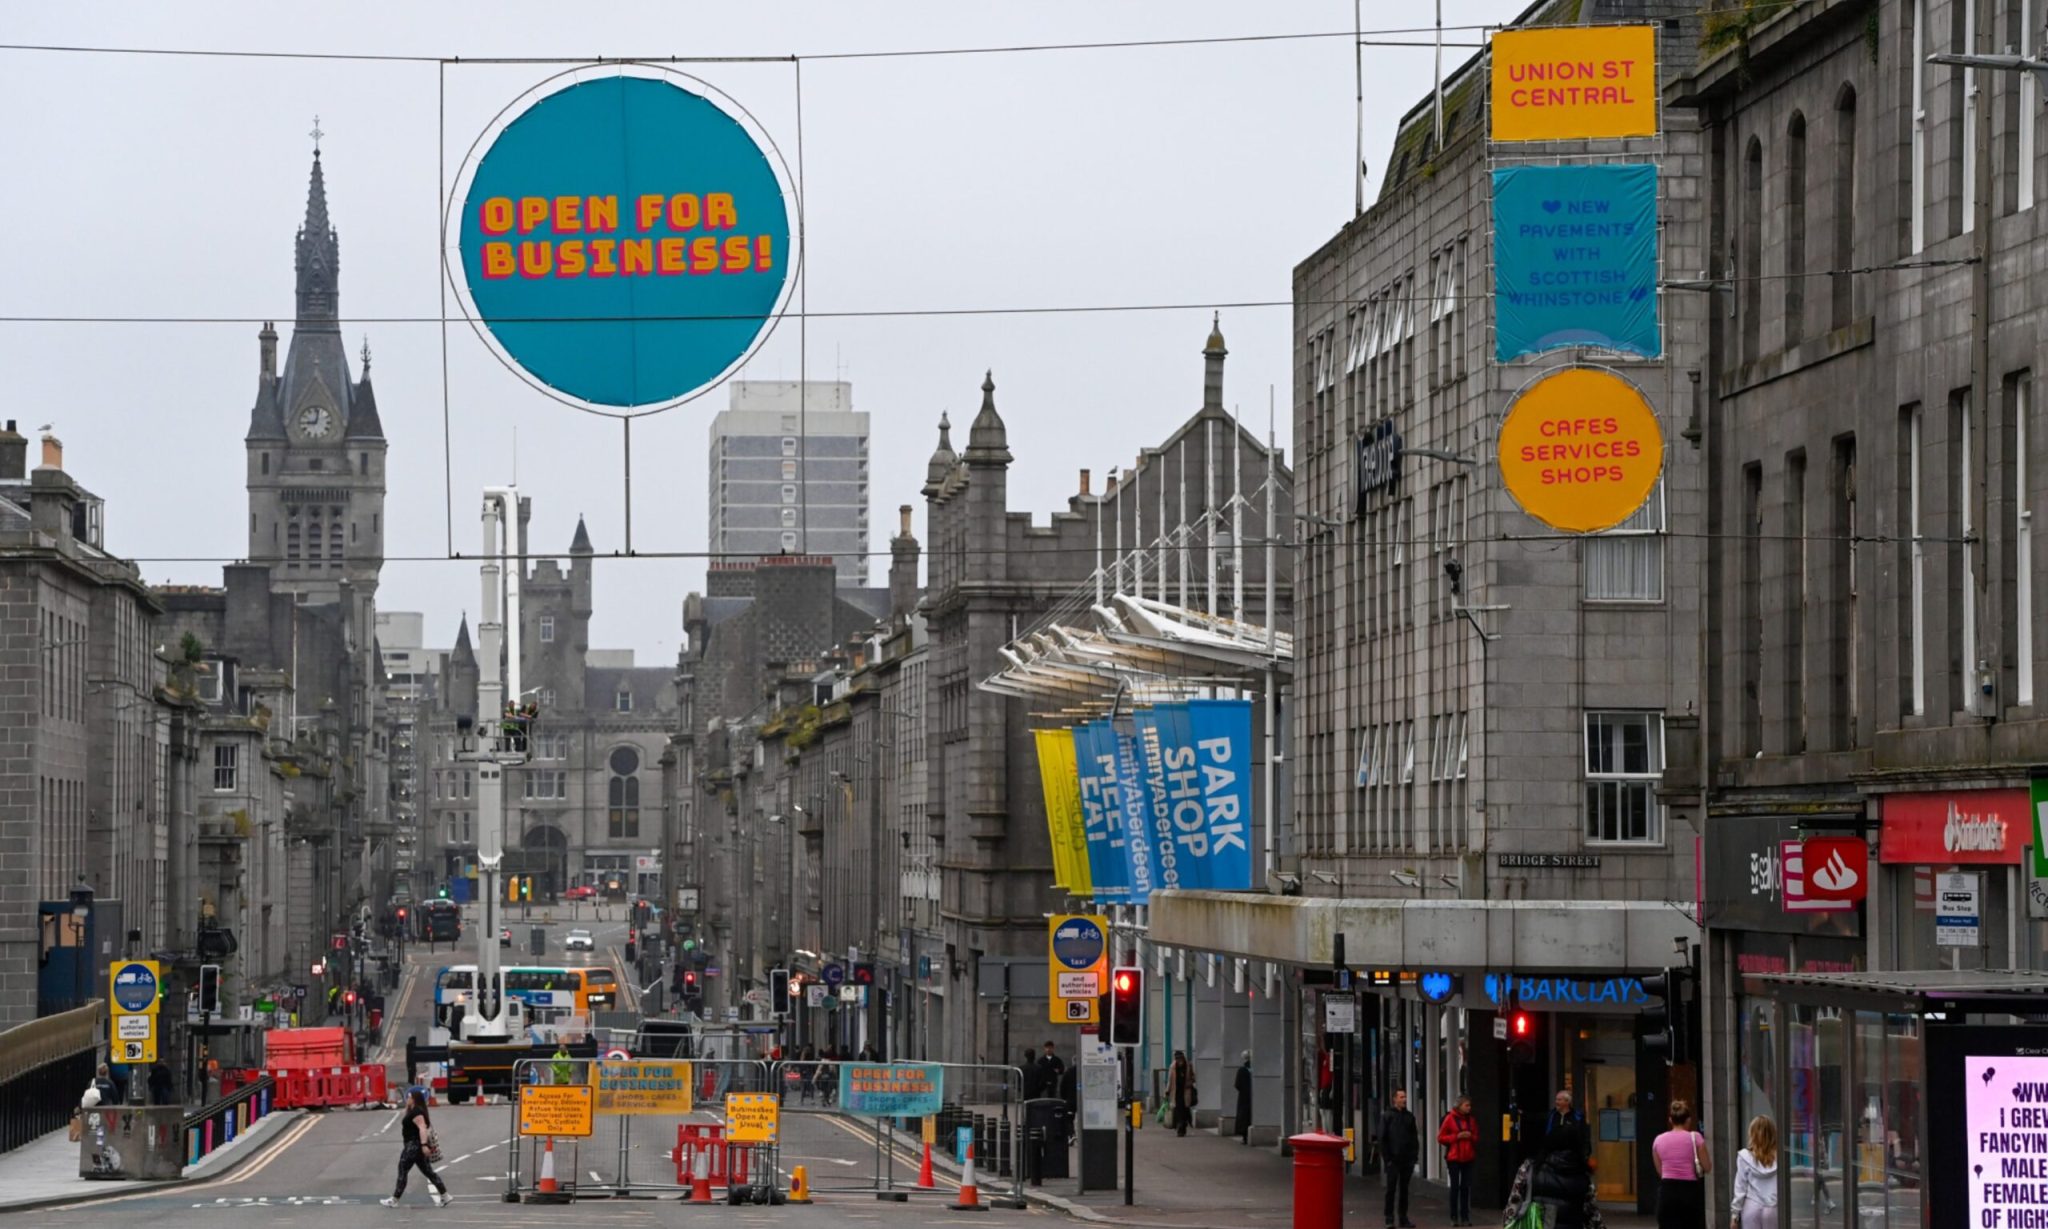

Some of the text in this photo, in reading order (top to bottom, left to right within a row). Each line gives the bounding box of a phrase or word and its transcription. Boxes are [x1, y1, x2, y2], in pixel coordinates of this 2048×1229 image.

[1509, 60, 1635, 82] UNION ST
[1510, 86, 1635, 107] CENTRAL
[479, 192, 737, 236] OPEN FOR
[1567, 200, 1610, 215] NEW
[1519, 223, 1634, 238] PAVEMENTS
[481, 235, 773, 279] BUSINESS!
[1553, 247, 1600, 261] WITH
[1529, 270, 1627, 286] SCOTTISH
[1508, 290, 1623, 307] WHINSTONE
[1540, 417, 1618, 437] CAFES
[1521, 440, 1641, 462] SERVICES
[1541, 465, 1624, 485] SHOPS
[1164, 746, 1209, 858] SHOP
[1198, 737, 1246, 856] PARK
[1500, 855, 1600, 866] BRIDGE STREET
[1519, 978, 1649, 1003] BARCLAYS
[600, 1066, 673, 1078] OPEN FOR
[851, 1068, 926, 1080] OPEN FOR
[599, 1079, 684, 1091] BUSINESS!
[851, 1081, 935, 1093] BUSINESS!
[740, 1121, 763, 1129] Usual
[2000, 1107, 2004, 1128] I
[2001, 1158, 2047, 1178] MALE
[1984, 1183, 2048, 1204] FEMALE
[1982, 1208, 2048, 1229] OF HIGH
